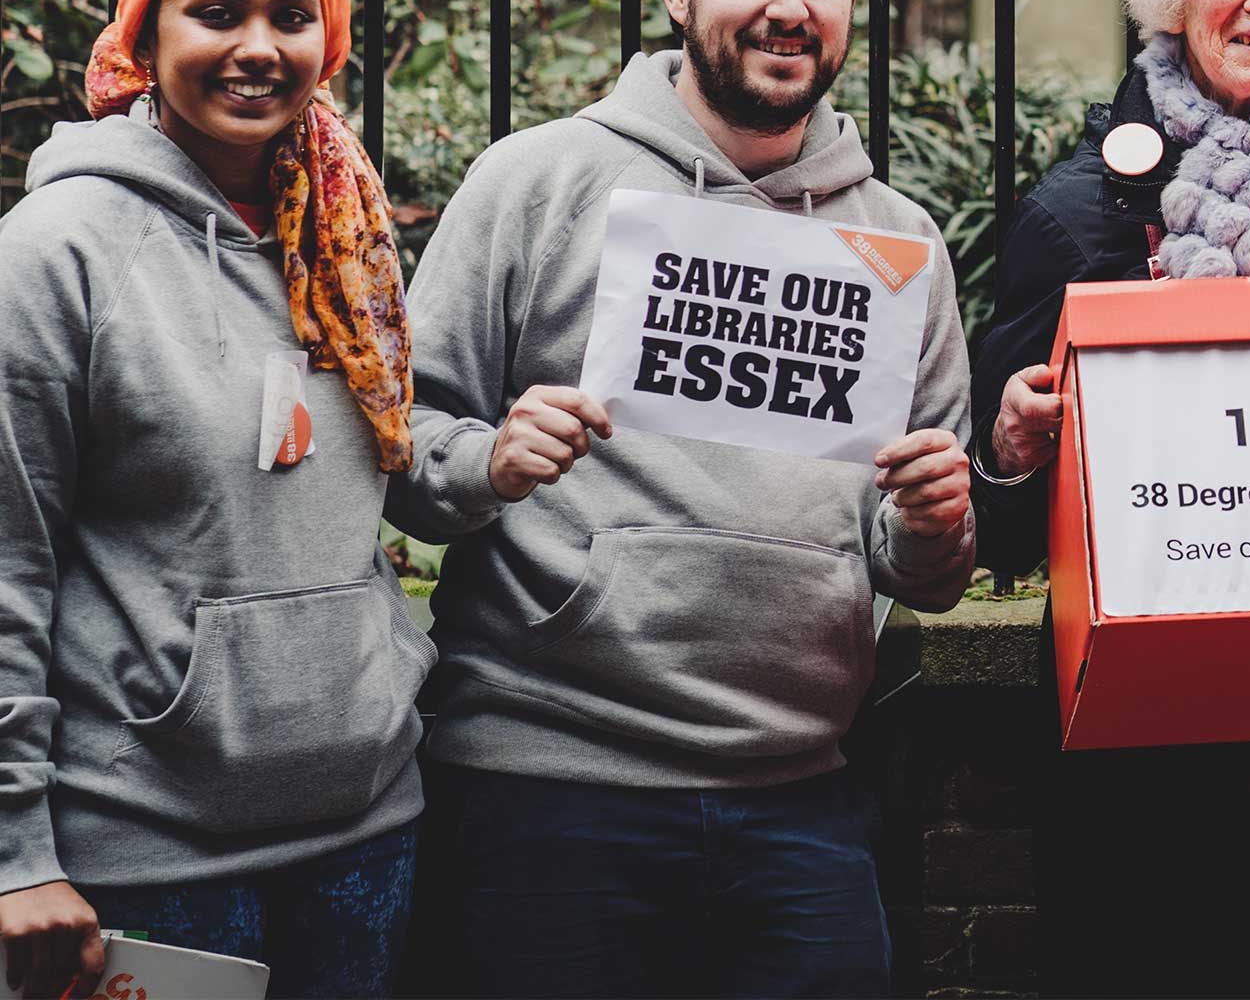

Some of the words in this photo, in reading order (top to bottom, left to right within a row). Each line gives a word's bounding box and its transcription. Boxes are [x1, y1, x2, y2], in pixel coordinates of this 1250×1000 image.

[851, 233, 872, 254] 38
[651, 252, 770, 305] SAVE
[781, 272, 871, 323] OUR
[642, 295, 866, 362] LIBRARIES
[633, 335, 861, 425] ESSEX
[1130, 482, 1169, 509] 38
[1167, 537, 1232, 562] Save
